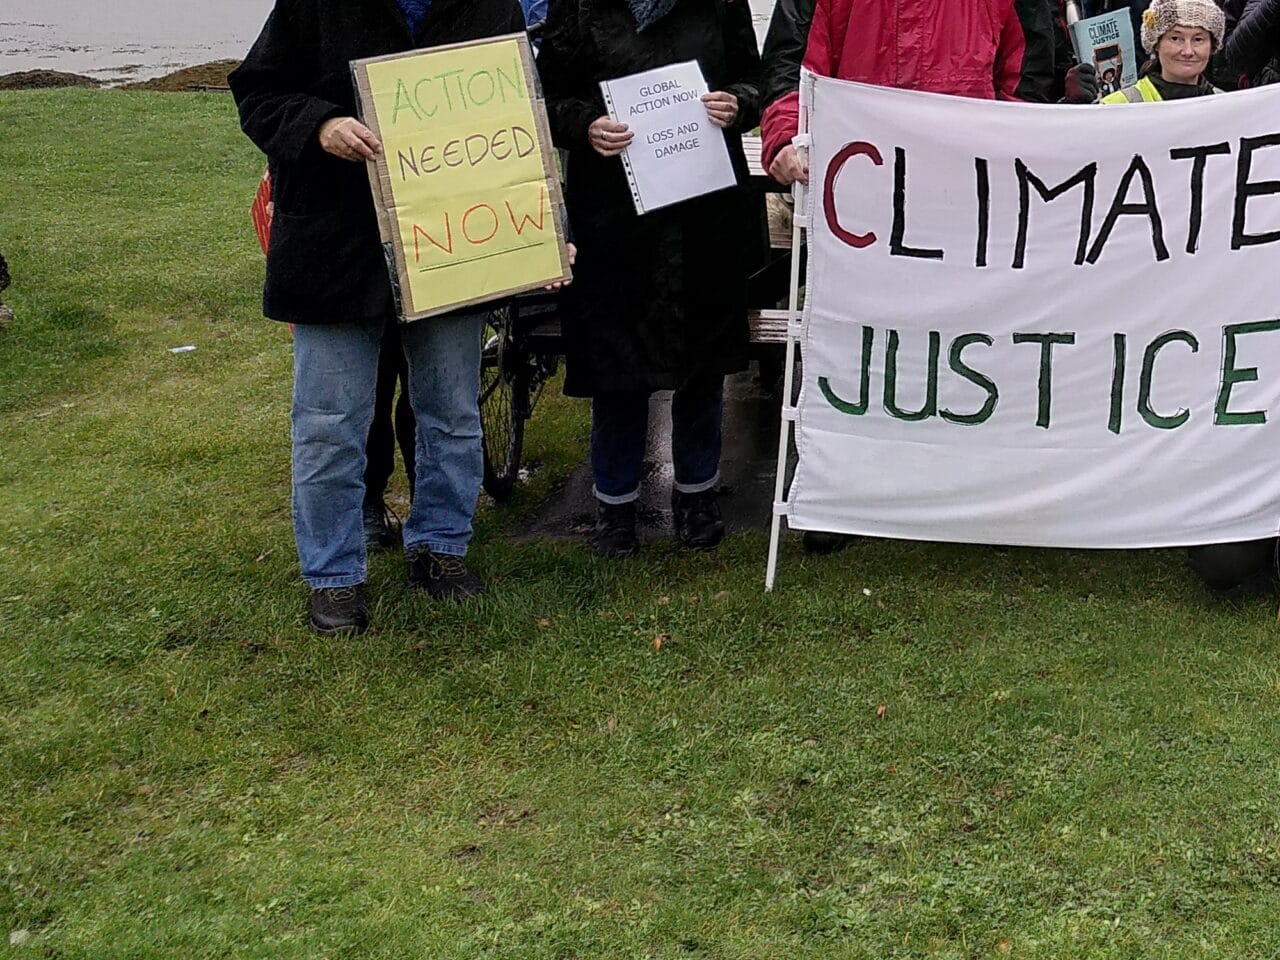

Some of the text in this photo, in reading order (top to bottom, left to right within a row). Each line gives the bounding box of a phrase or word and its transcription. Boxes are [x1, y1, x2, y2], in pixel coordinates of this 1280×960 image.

[1088, 20, 1119, 40] CLIMATE
[1092, 31, 1120, 46] JUSTICE
[392, 57, 525, 125] ACTION
[639, 79, 682, 98] GLOBAL
[629, 90, 699, 116] ACTION NOW
[646, 122, 699, 145] LOSS AND
[397, 126, 536, 182] NEEDED
[654, 138, 701, 159] DAMAGE
[412, 186, 545, 263] NOW
